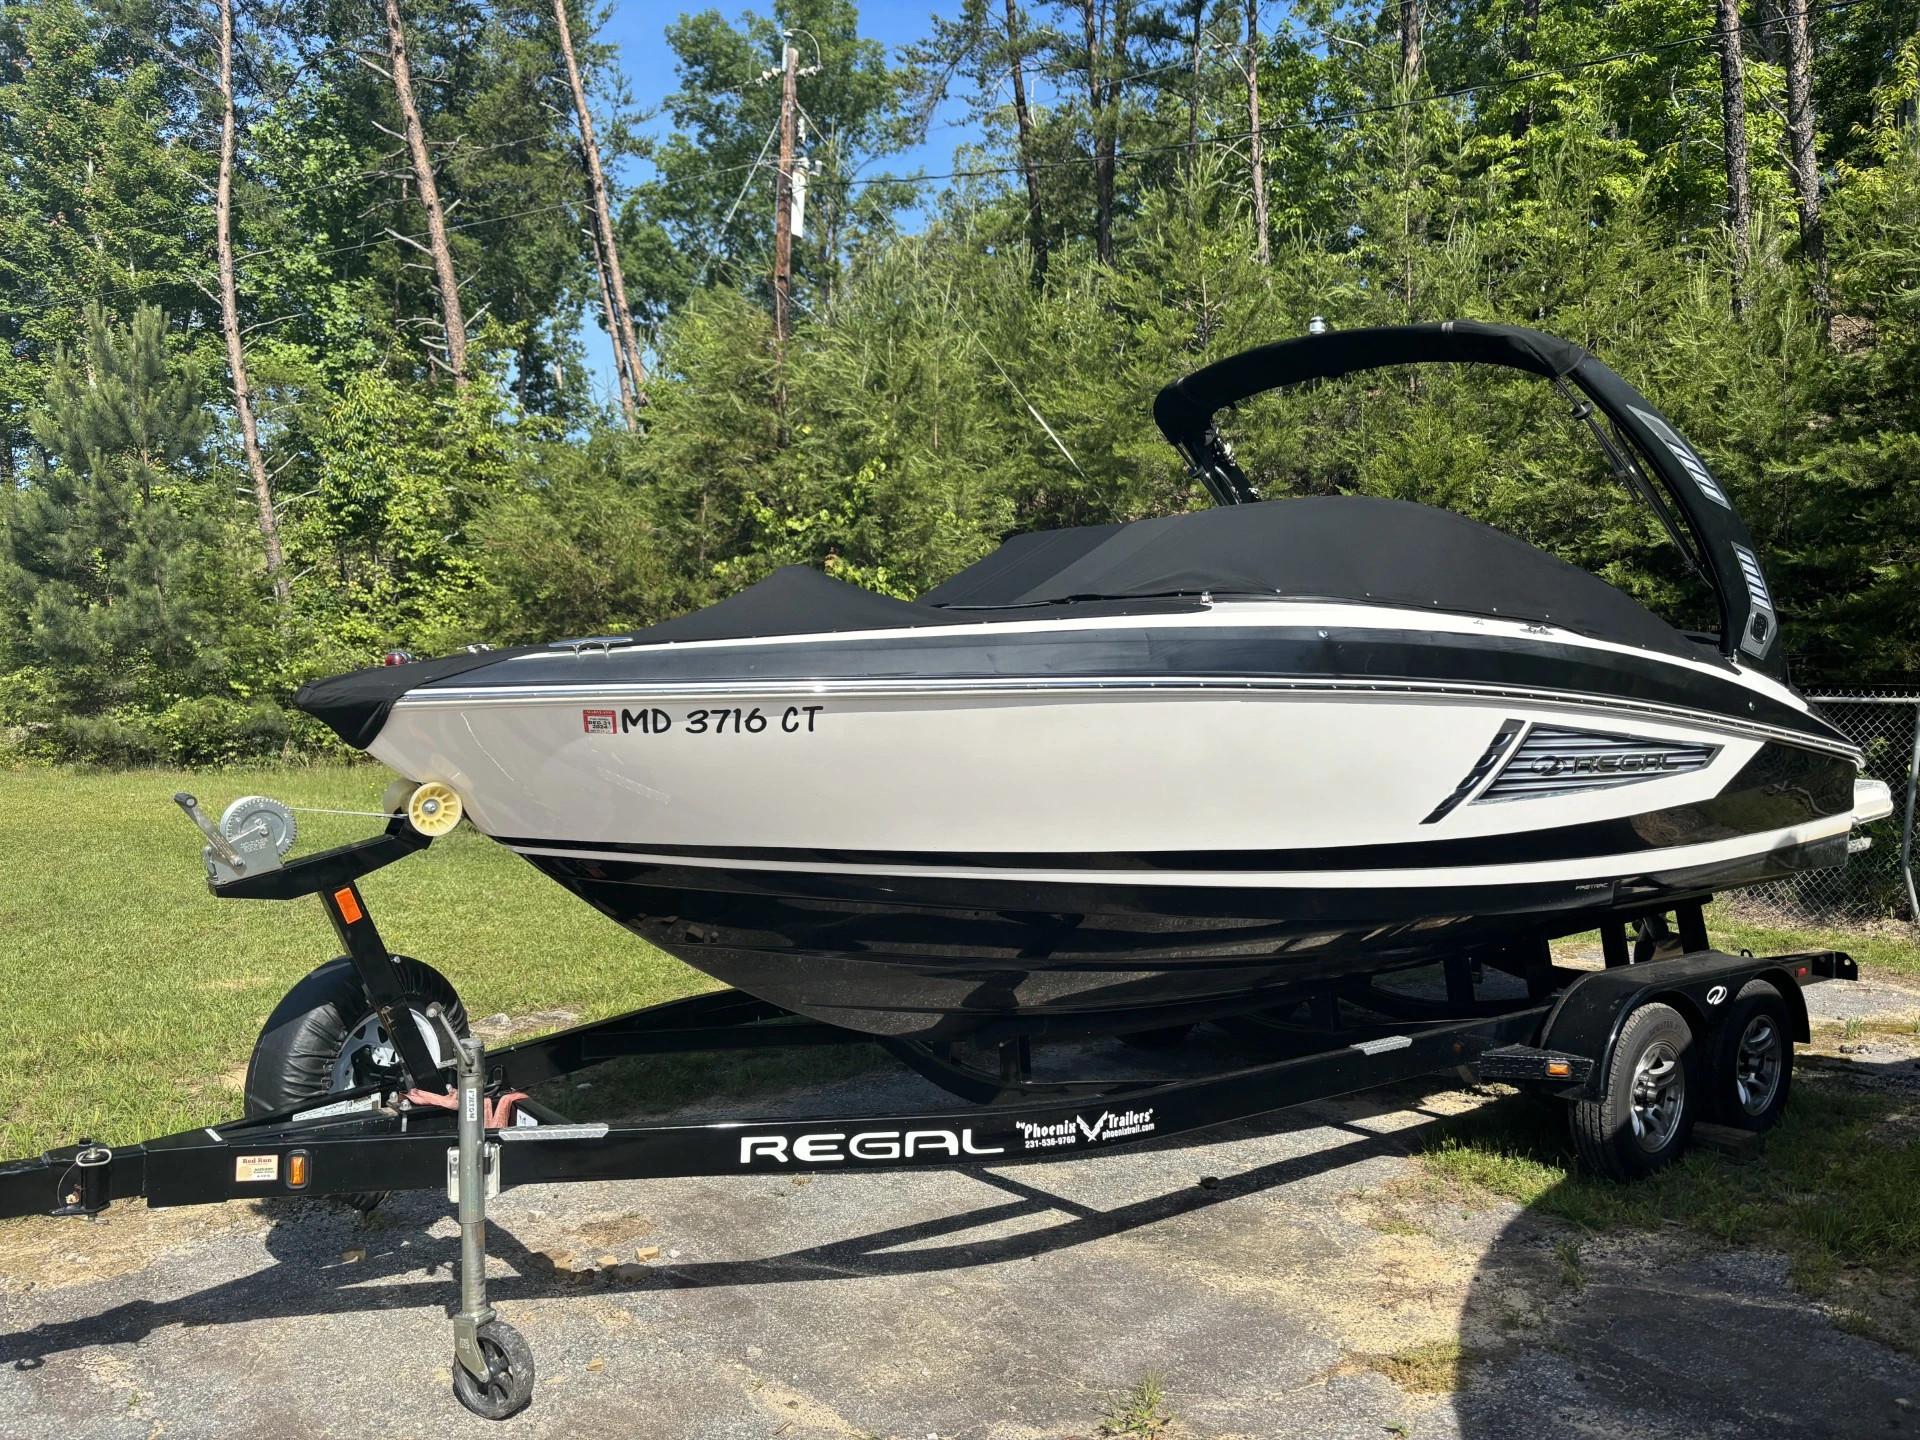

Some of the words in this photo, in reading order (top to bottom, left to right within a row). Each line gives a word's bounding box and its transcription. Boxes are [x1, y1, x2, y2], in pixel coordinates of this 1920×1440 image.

[621, 708, 672, 734] MD
[685, 707, 767, 734] 3716
[781, 706, 824, 733] CT
[1572, 753, 1681, 774] REGAL
[1024, 1119, 1077, 1139] Phoenix
[740, 1129, 1005, 1163] REGAL
